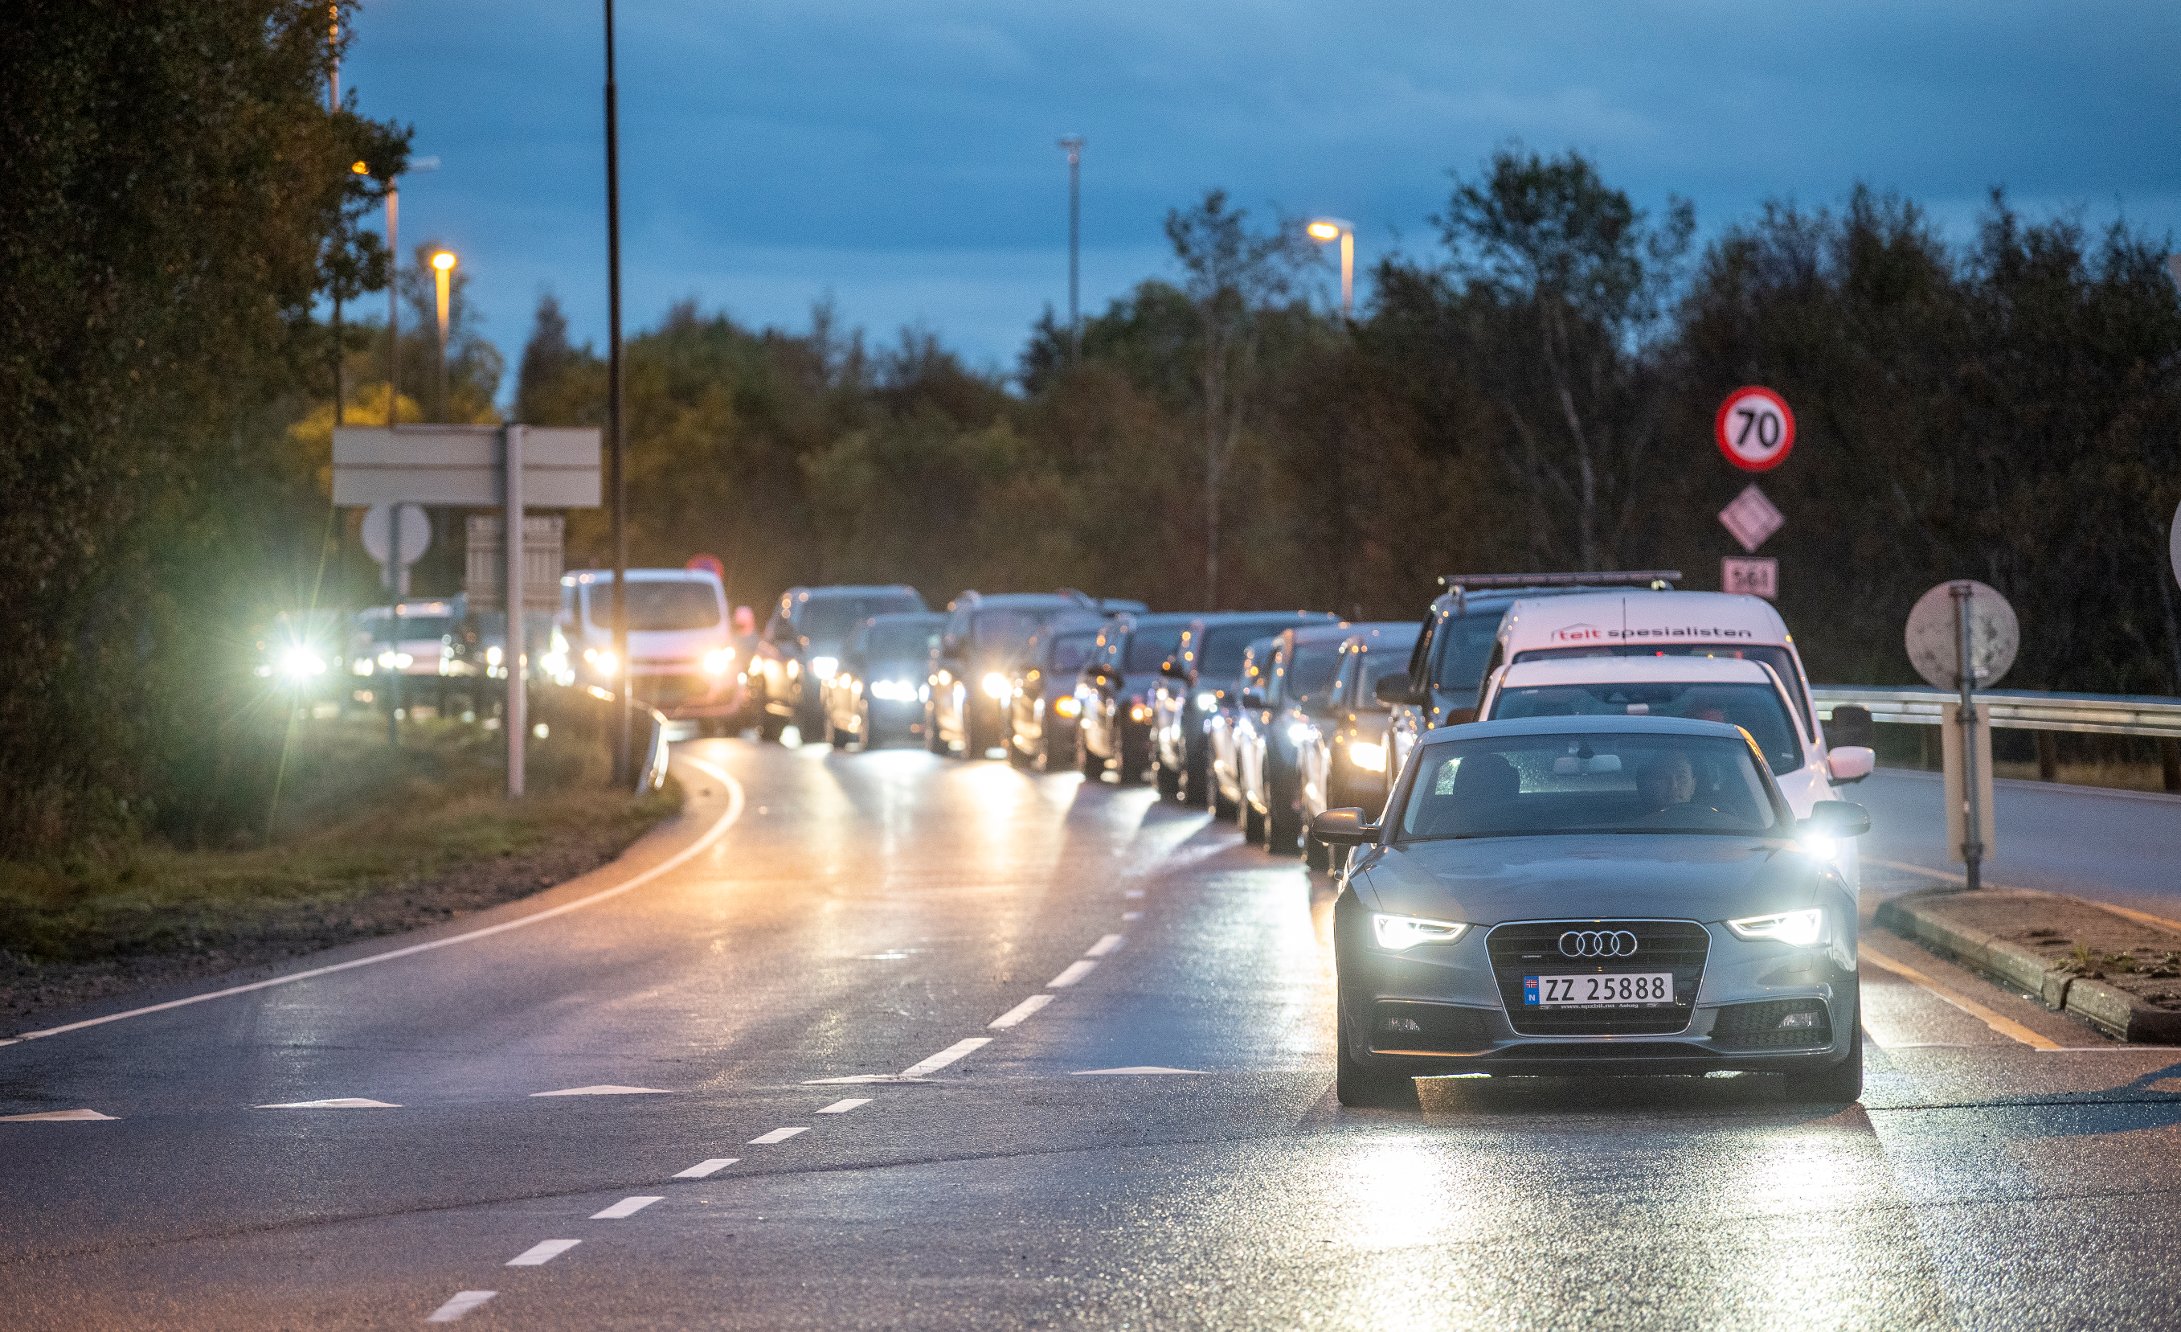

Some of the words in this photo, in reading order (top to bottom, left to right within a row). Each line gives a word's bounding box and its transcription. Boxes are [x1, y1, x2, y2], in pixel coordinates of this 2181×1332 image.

[1737, 408, 1780, 448] 70
[1608, 625, 1752, 640] spesialisten
[1545, 978, 1575, 1002] ZZ
[1587, 976, 1666, 1000] 25888
